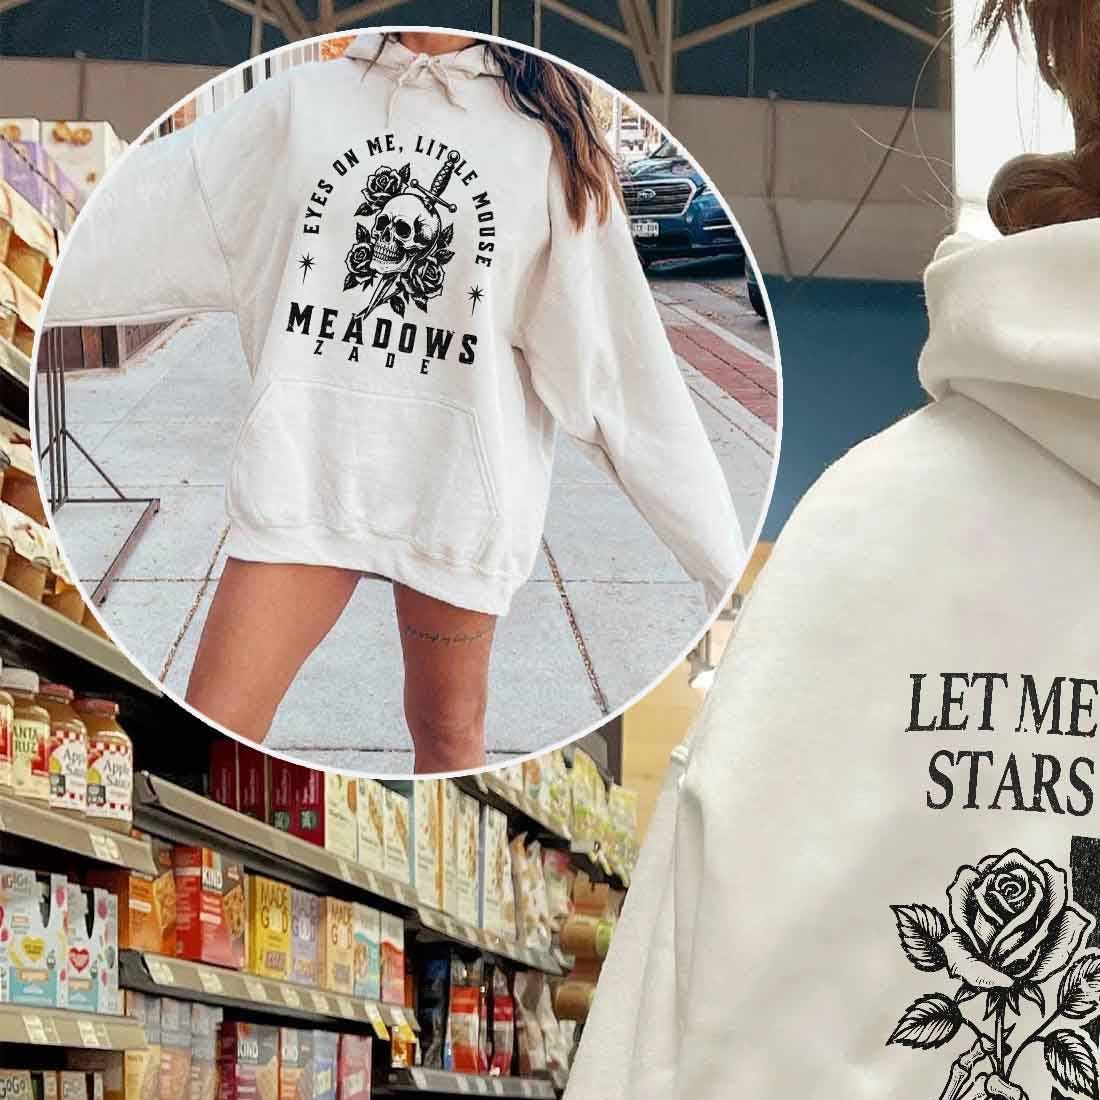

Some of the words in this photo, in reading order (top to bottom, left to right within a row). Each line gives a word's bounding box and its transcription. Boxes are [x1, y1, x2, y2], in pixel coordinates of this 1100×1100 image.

[303, 179, 335, 235] EYES
[332, 149, 361, 177] ON
[366, 134, 404, 157] ME,
[415, 135, 478, 187] LITLE
[472, 191, 497, 268] MOUSE
[286, 301, 478, 364] MEADOWS
[313, 339, 431, 375] ZADE
[13, 725, 39, 741] ANTA
[905, 672, 1009, 733] LET
[1014, 673, 1099, 738] ME
[15, 739, 38, 754] RUZ
[926, 749, 1095, 817] STARS
